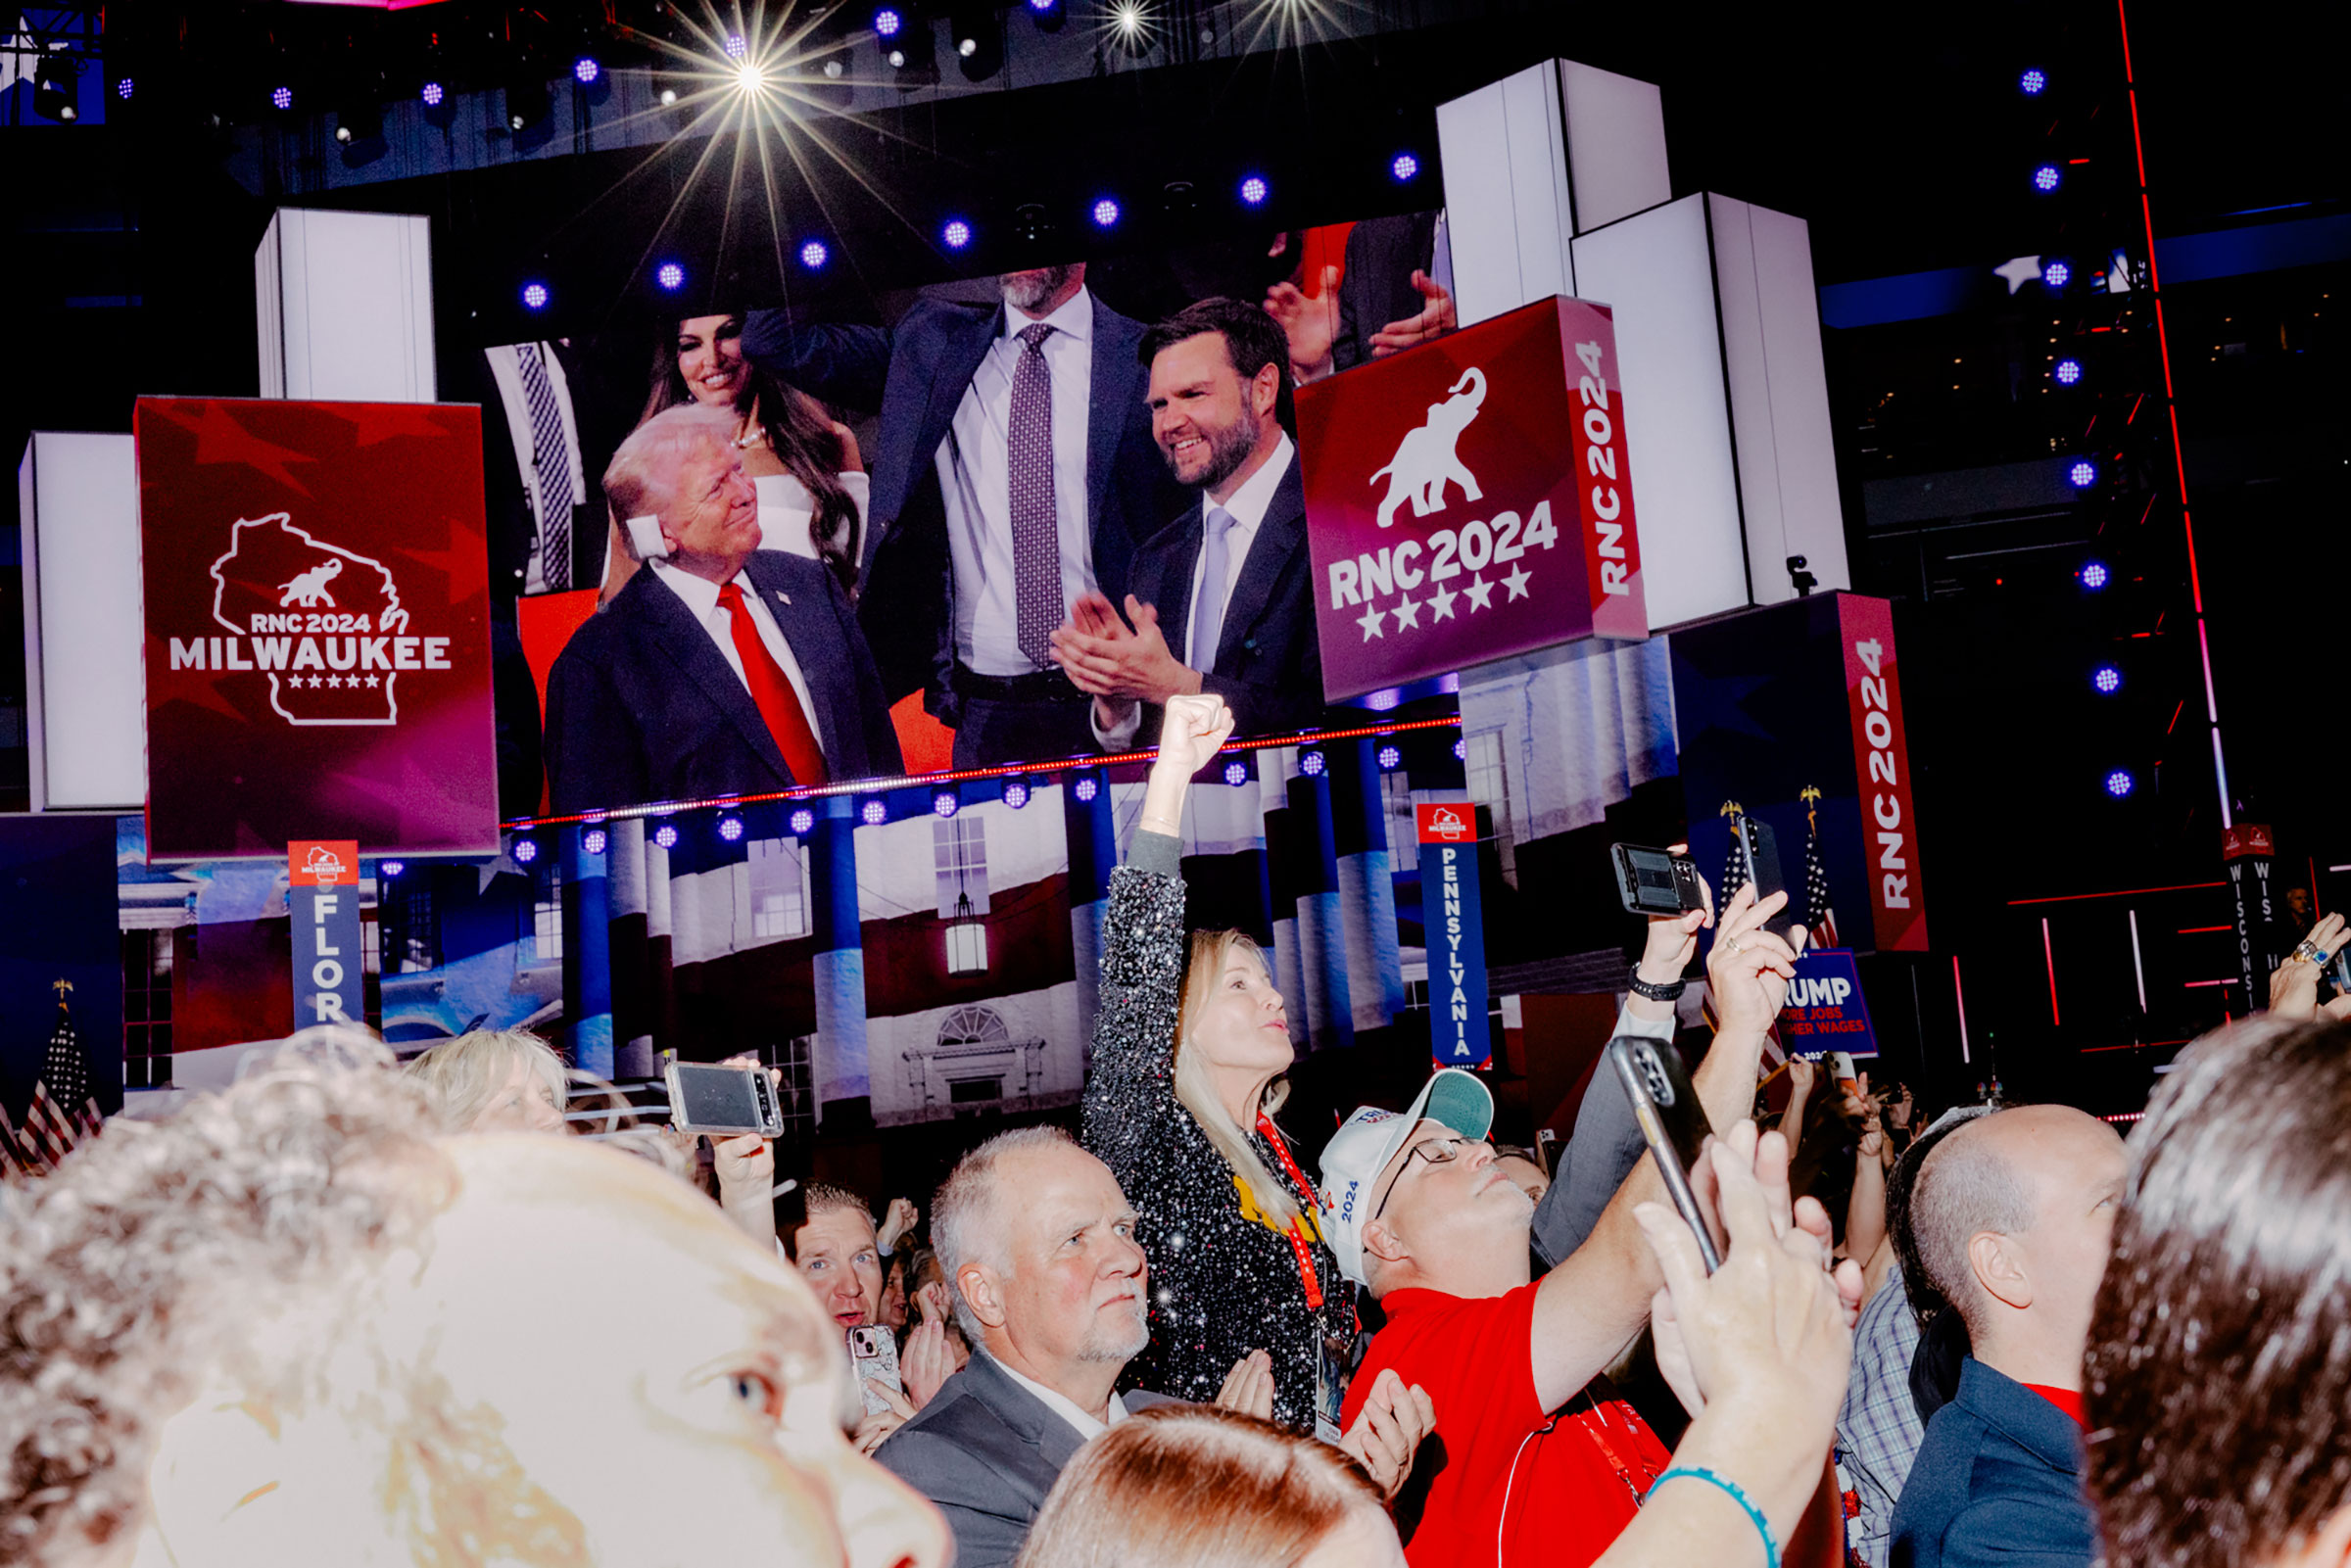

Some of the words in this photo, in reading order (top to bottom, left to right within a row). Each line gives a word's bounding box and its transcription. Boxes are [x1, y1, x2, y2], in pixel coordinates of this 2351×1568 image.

[1574, 341, 1617, 480] 2024
[1328, 540, 1424, 610] RNC
[1427, 499, 1559, 583] 2024
[1592, 486, 1630, 596] RNC
[169, 637, 452, 671] MILWAUKEE
[251, 613, 303, 634] RNC
[306, 613, 371, 634] 2024
[1855, 638, 1897, 785] 2024
[1873, 793, 1910, 909] RNC
[312, 894, 344, 1022] FLOR
[1442, 848, 1470, 1057] PENNSYLVANIA
[2230, 864, 2256, 1015] WISCONSI
[1803, 1050, 1827, 1061] 202
[1809, 1007, 1843, 1021] JOBS
[1816, 1020, 1866, 1034] WAGES
[1341, 1180, 1360, 1224] 2024
